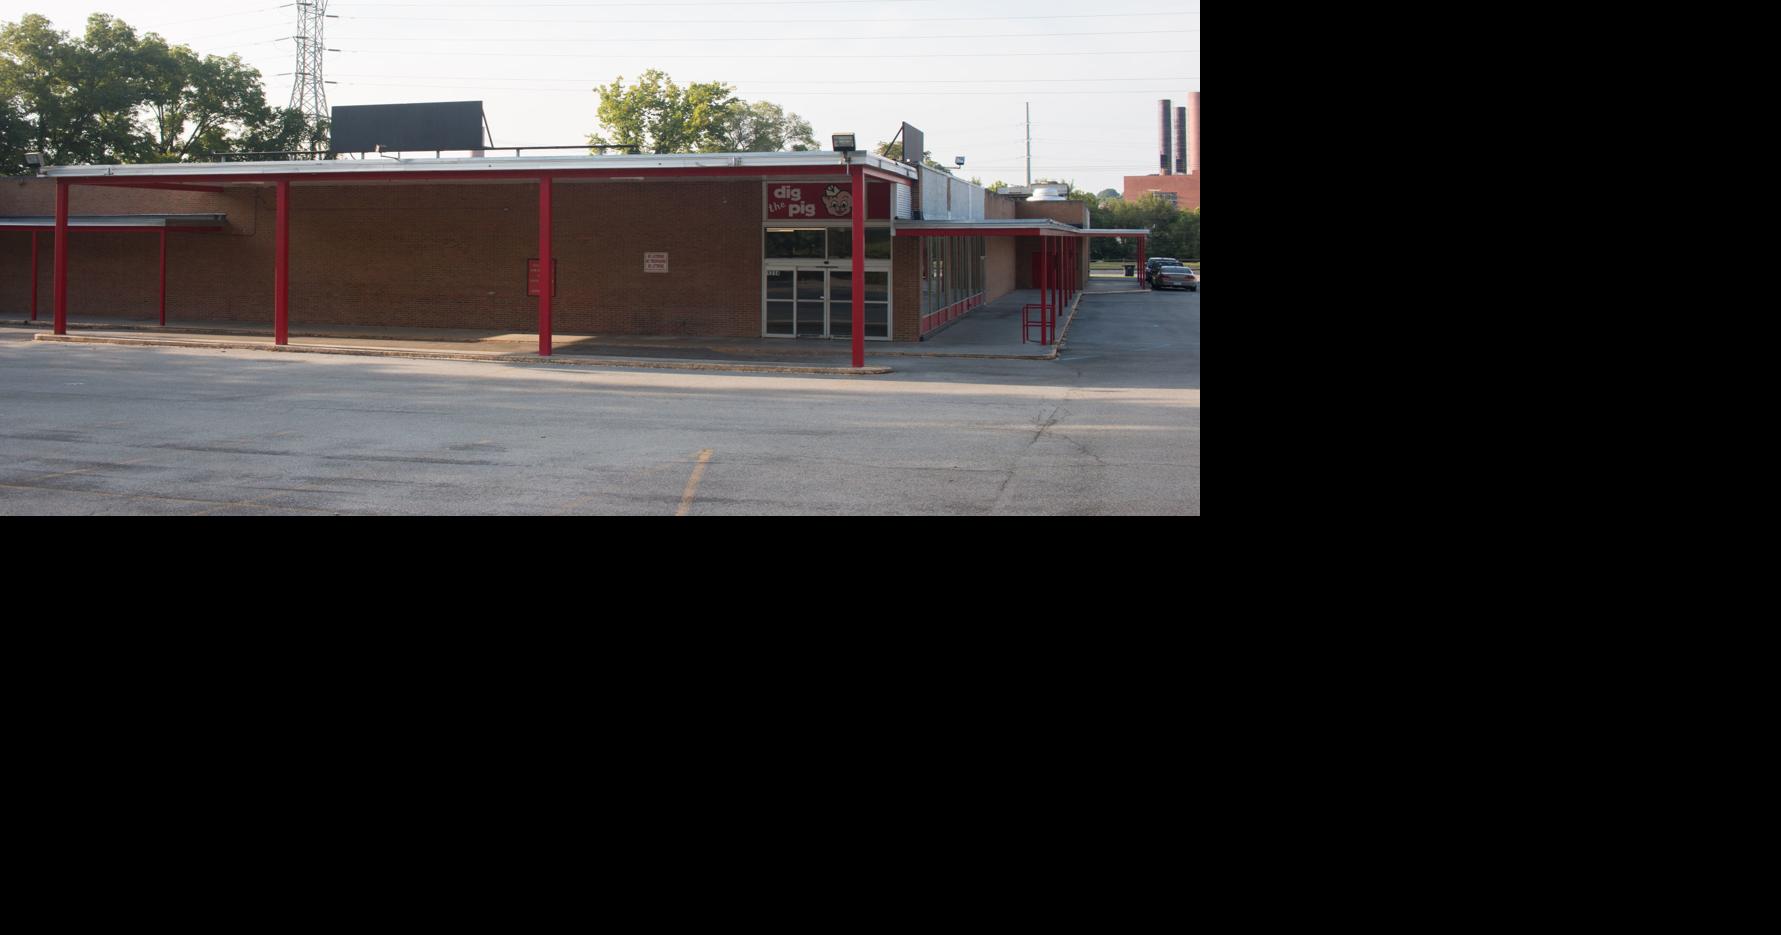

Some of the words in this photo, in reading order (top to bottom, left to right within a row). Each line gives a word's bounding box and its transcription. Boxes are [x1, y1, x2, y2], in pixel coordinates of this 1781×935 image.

[773, 186, 801, 201] dig
[768, 202, 785, 213] the
[788, 201, 816, 217] pig
